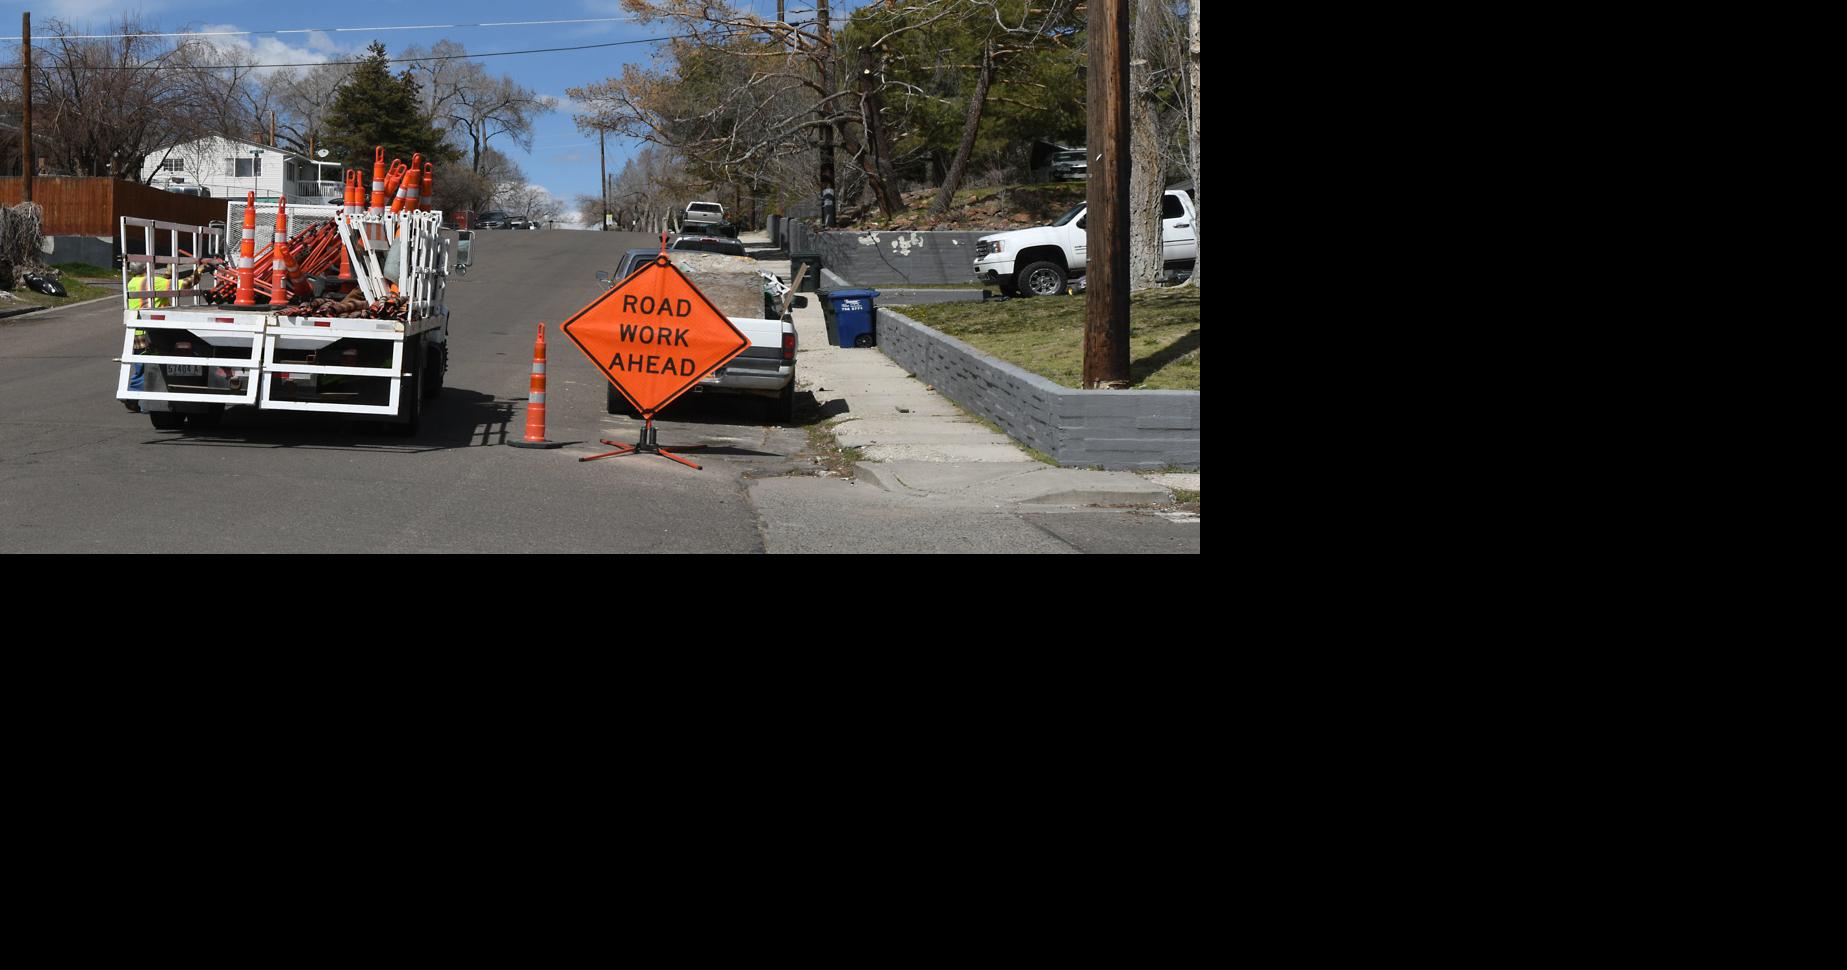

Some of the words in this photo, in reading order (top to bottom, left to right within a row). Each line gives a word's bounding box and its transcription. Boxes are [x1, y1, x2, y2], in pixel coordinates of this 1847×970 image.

[622, 294, 692, 317] ROAD
[619, 323, 690, 348] WORK
[608, 352, 696, 377] AHEAD
